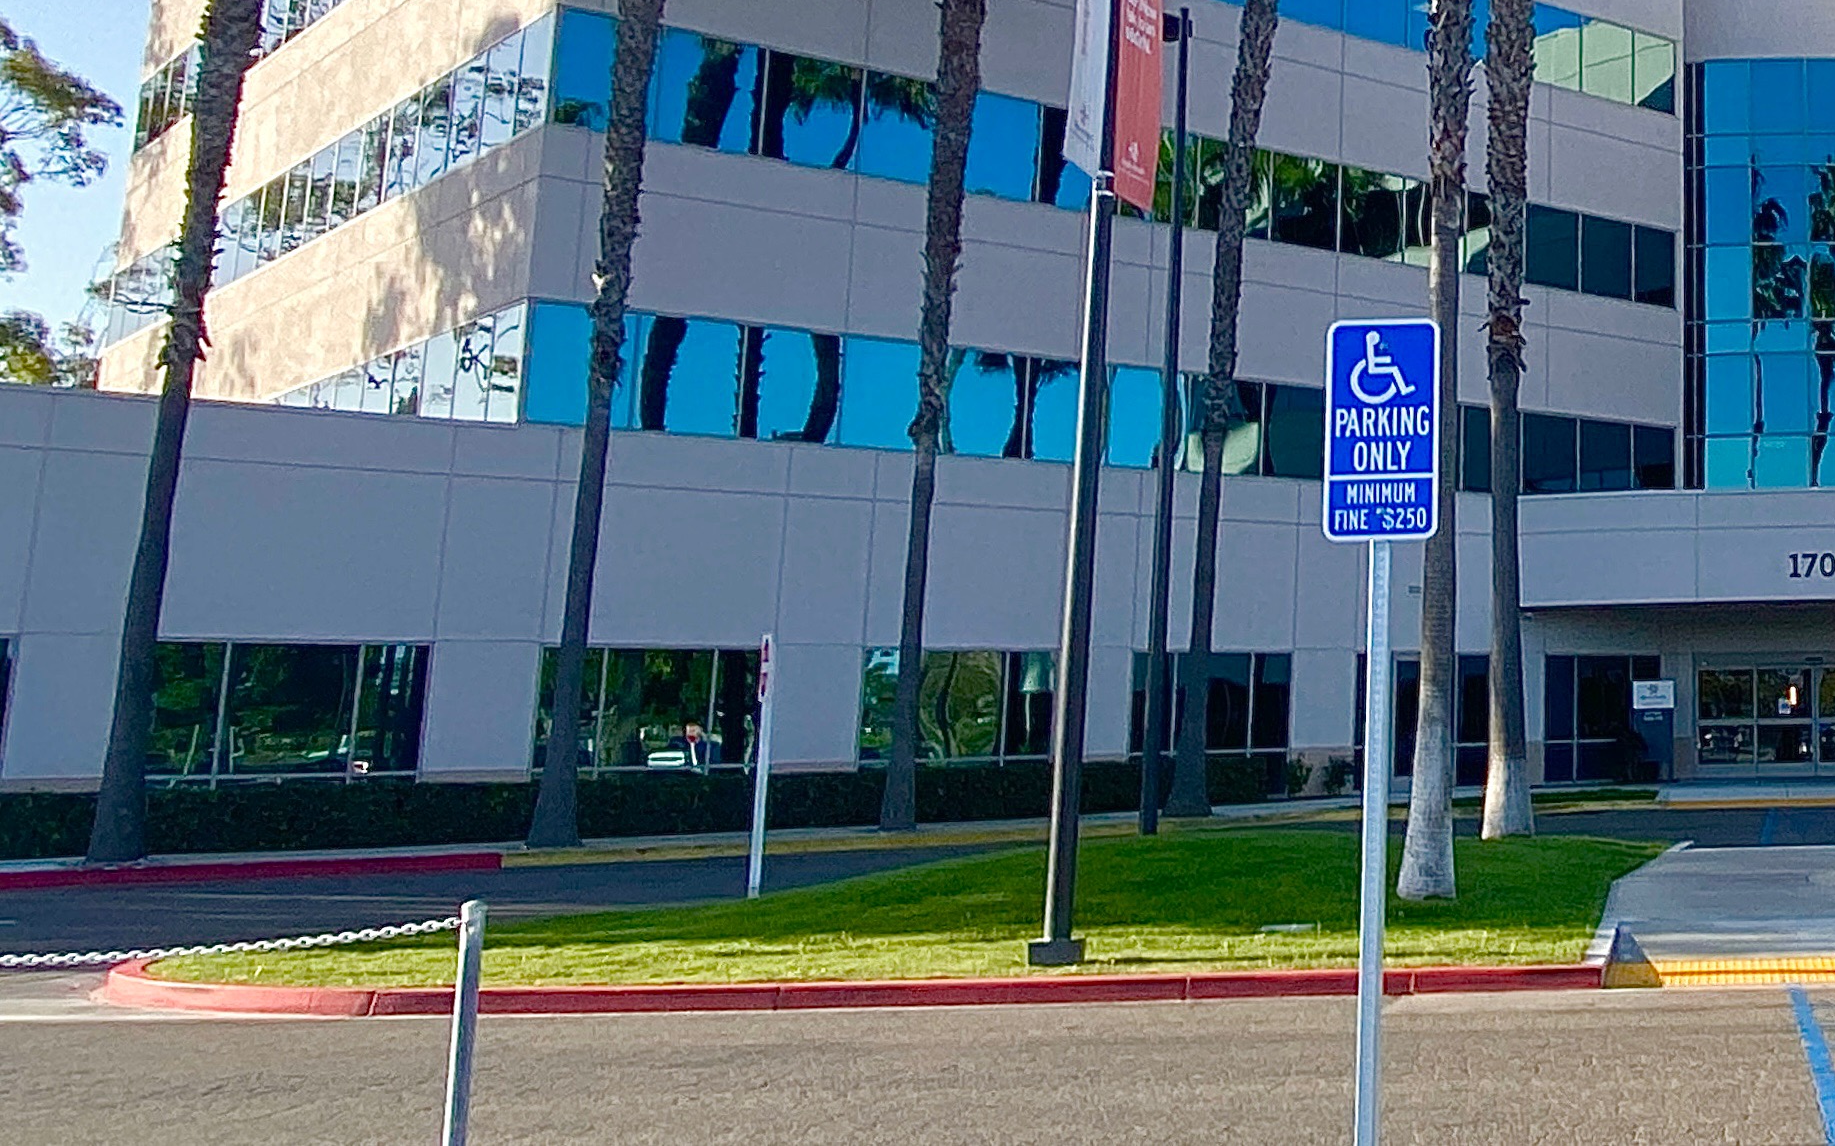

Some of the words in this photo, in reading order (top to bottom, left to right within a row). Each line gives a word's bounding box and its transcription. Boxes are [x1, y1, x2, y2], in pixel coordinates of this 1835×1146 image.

[1335, 405, 1430, 438] PARKING
[1353, 441, 1412, 471] ONLY
[1346, 482, 1416, 504] MINIMUM
[1334, 509, 1368, 530] FINE
